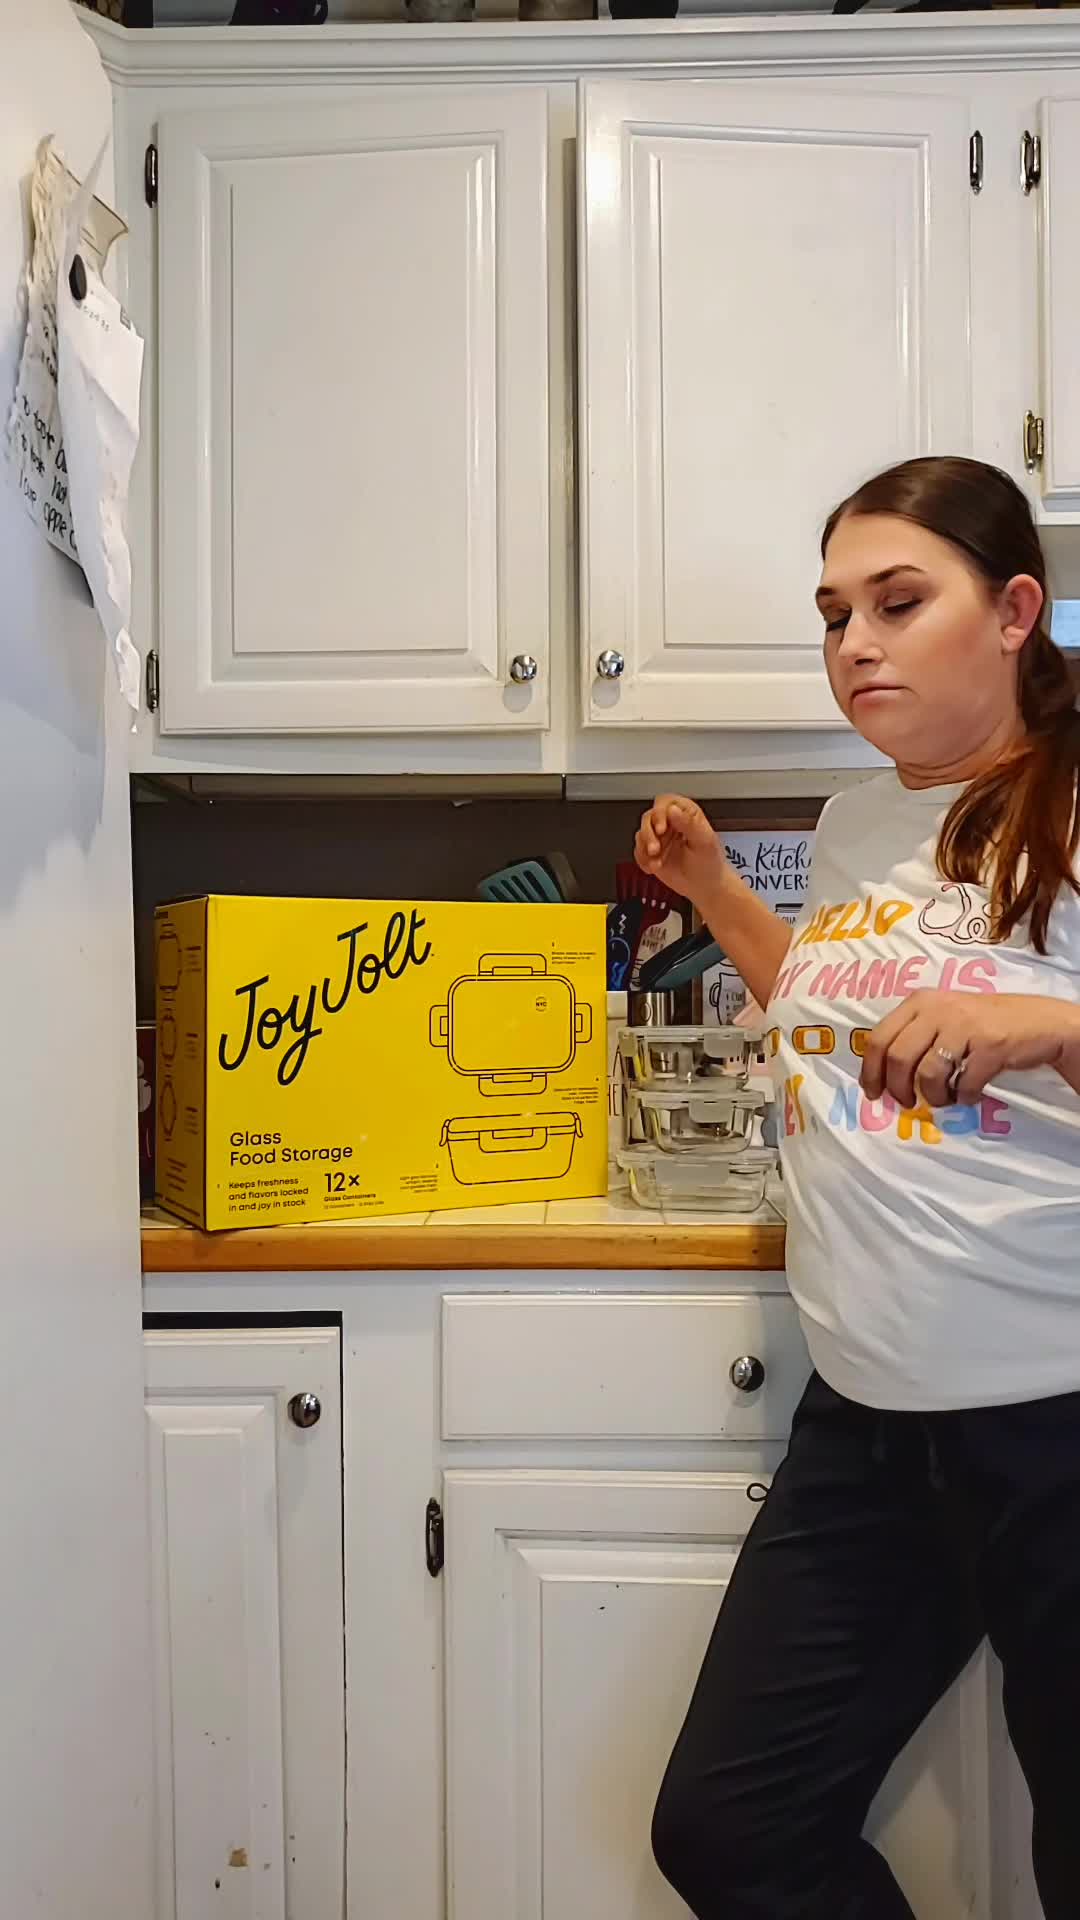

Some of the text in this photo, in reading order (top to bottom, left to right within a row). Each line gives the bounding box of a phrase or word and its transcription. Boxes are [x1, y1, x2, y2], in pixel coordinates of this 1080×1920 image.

[792, 894, 914, 952] HELLO
[807, 955, 928, 1001] NAME
[937, 957, 998, 993] IS
[230, 1131, 282, 1147] Glass
[230, 1146, 353, 1167] Food Storage
[229, 1178, 299, 1189] Keeps freshness
[248, 1190, 279, 1199] flavors
[280, 1187, 309, 1196] locked
[238, 1203, 257, 1211] and
[258, 1202, 272, 1211] joy
[273, 1200, 281, 1208] in
[282, 1198, 306, 1207] stock
